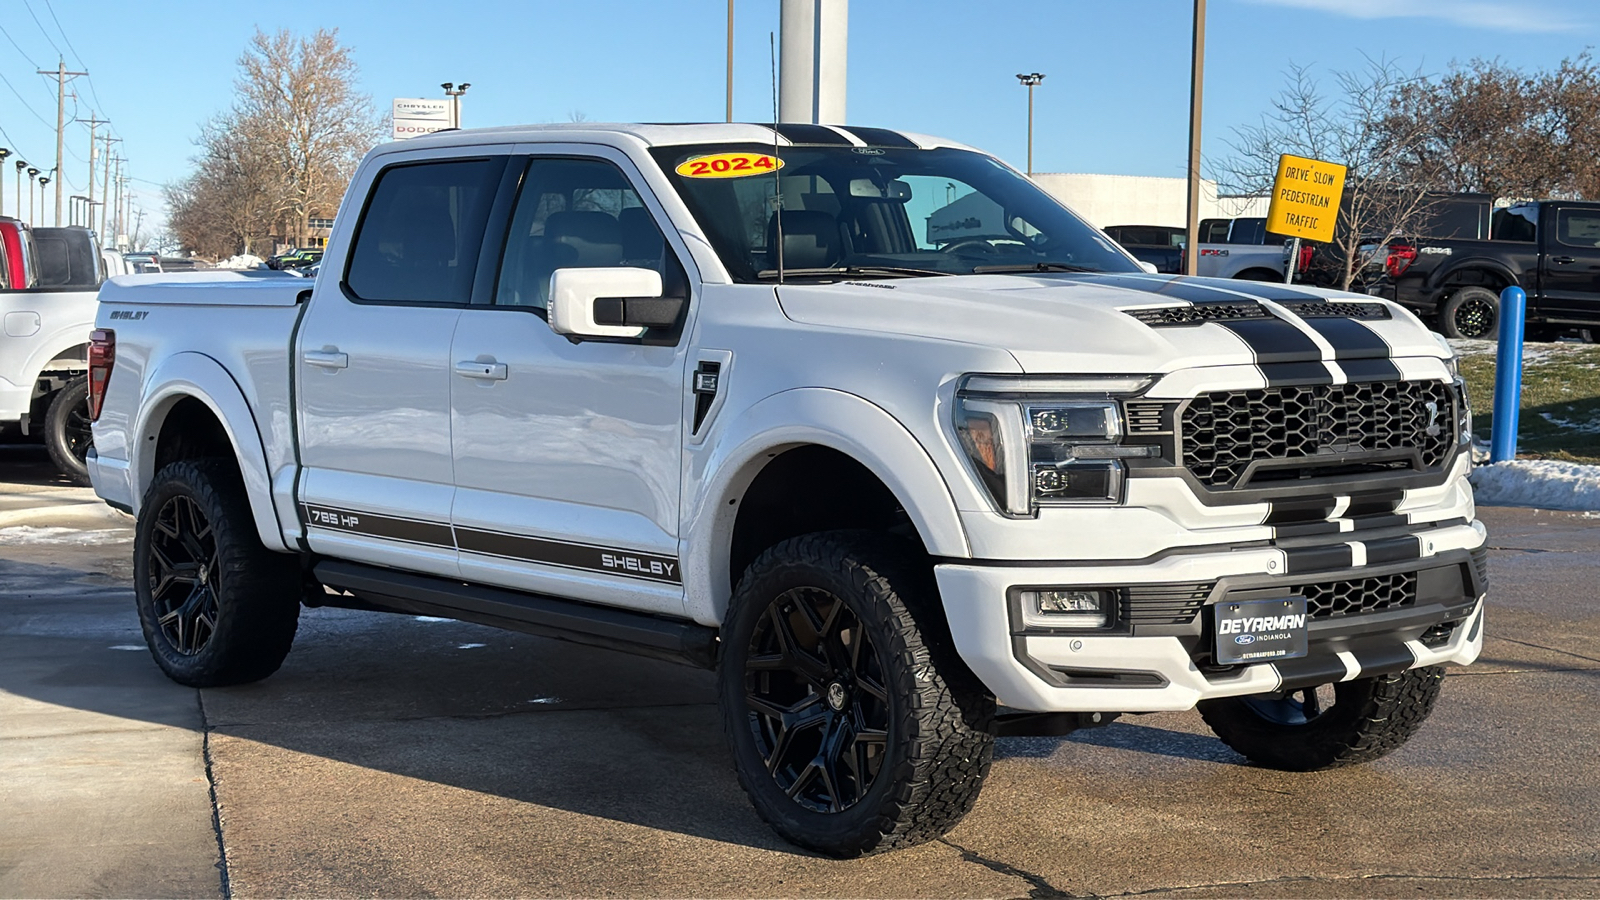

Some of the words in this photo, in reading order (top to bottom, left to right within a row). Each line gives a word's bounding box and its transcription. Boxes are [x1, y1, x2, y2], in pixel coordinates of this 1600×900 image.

[690, 156, 774, 175] 2024
[1285, 166, 1310, 182] DRIVE
[1313, 171, 1336, 186] SLOW
[1280, 188, 1330, 208] PEDESTRIAN
[1285, 212, 1319, 230] TRAFFIC
[109, 310, 150, 321] SHELBY
[311, 510, 339, 525] 785
[340, 514, 359, 528] HP
[601, 553, 675, 577] SHELBY
[1219, 614, 1306, 635] DEYARMAN
[1256, 633, 1292, 642] INDIANOLA
